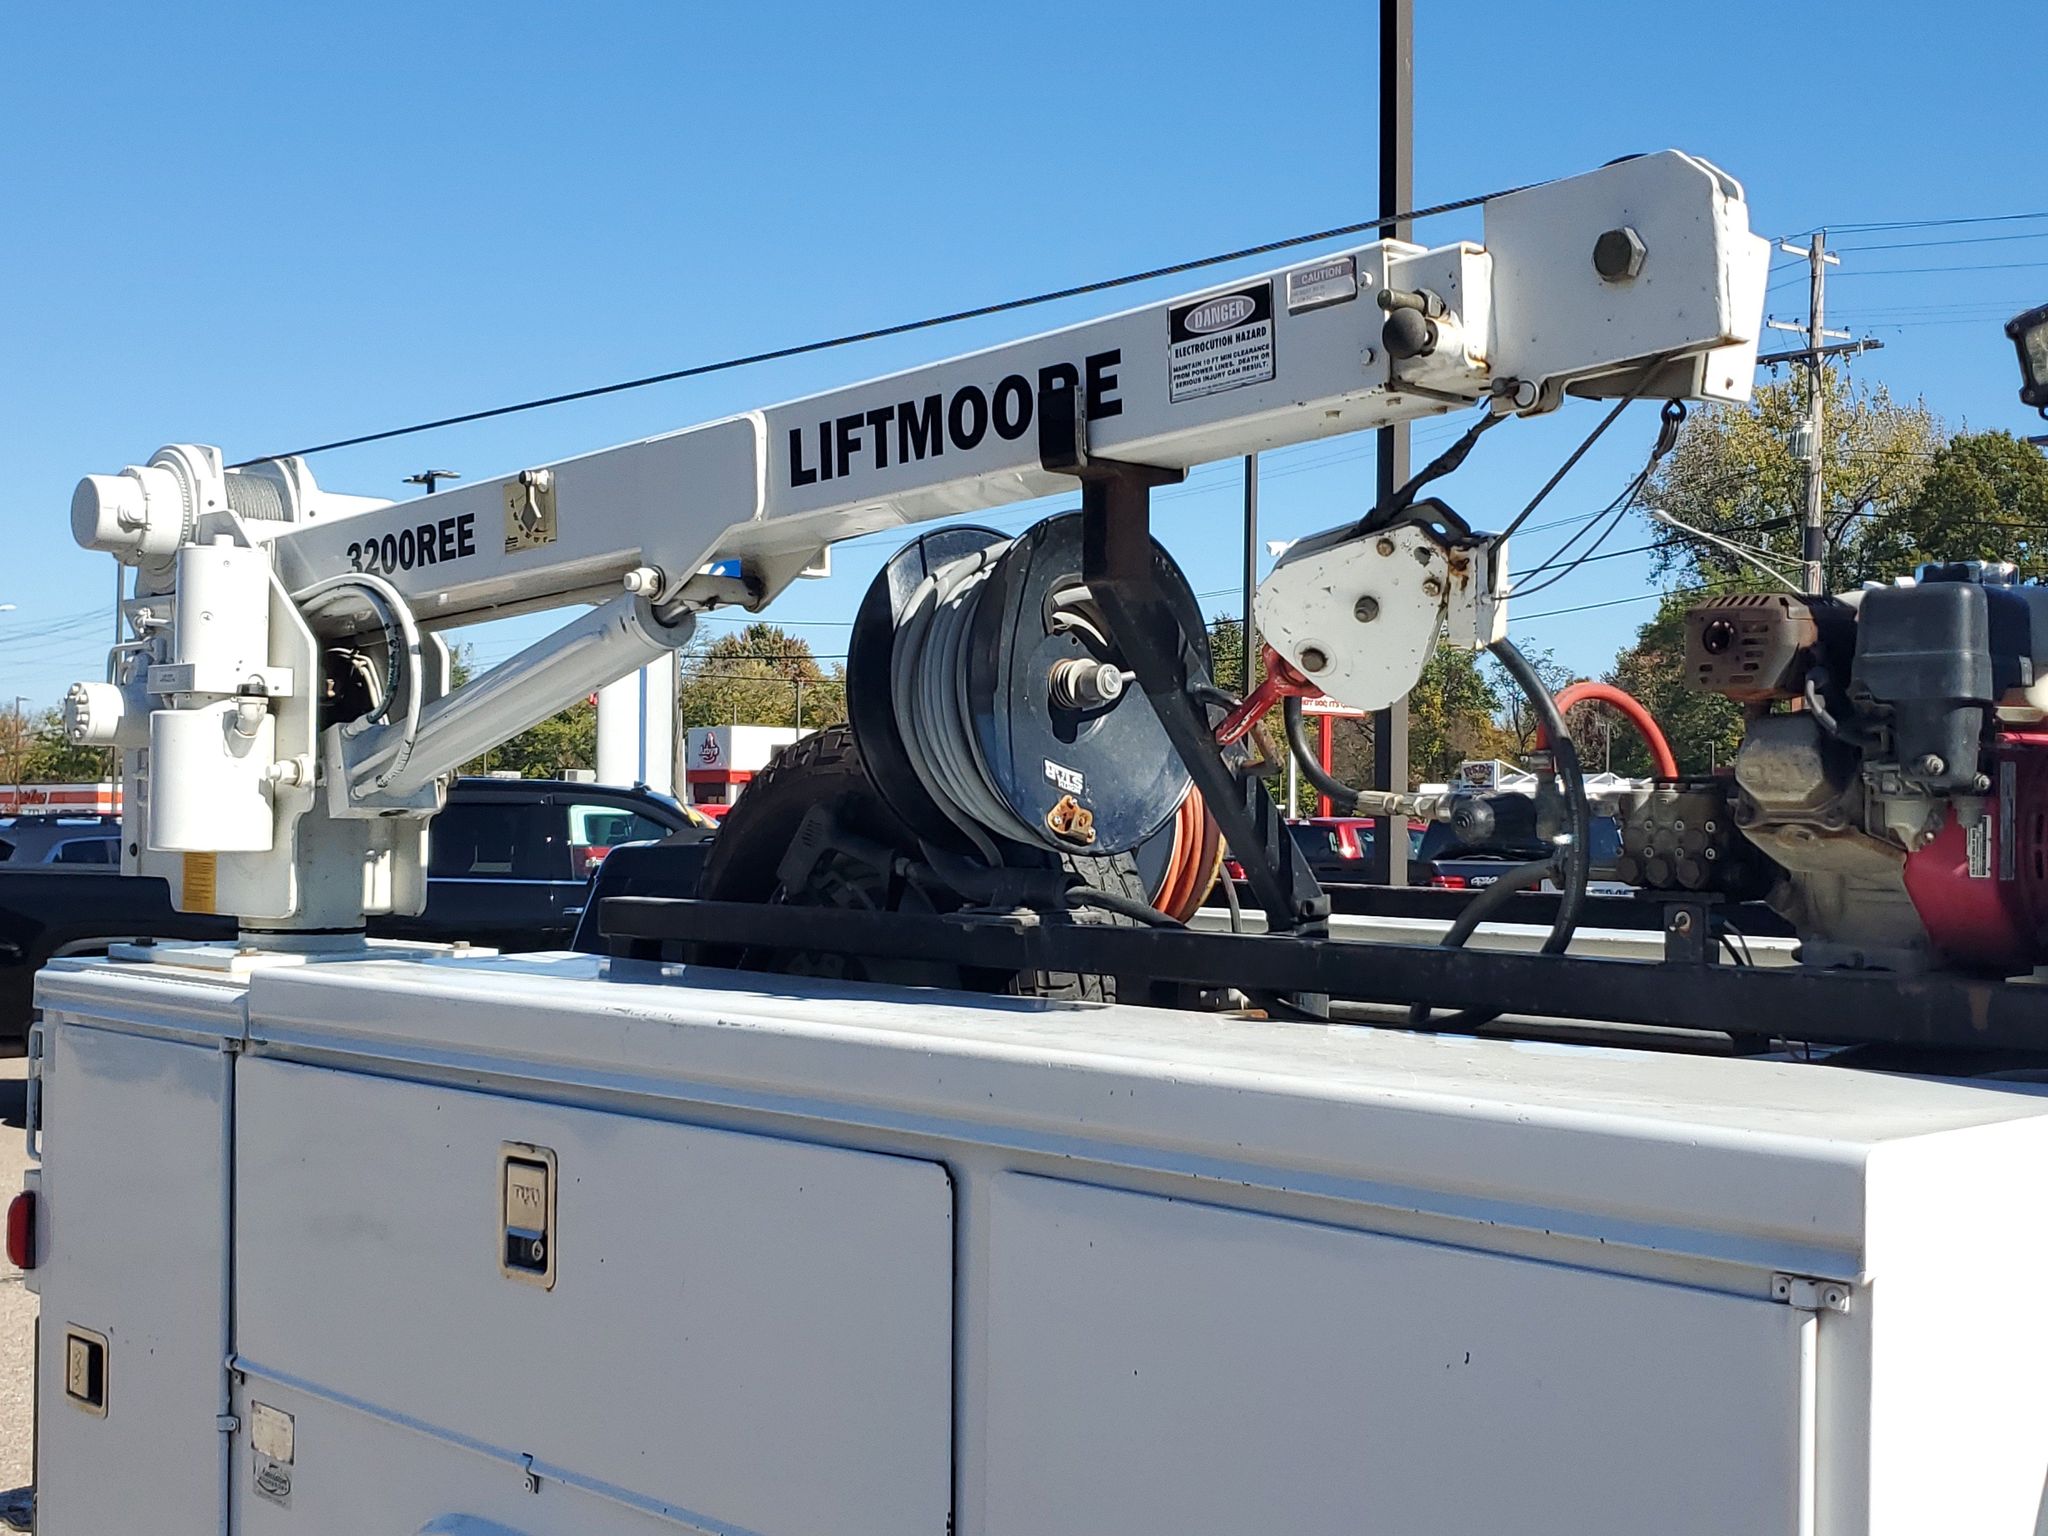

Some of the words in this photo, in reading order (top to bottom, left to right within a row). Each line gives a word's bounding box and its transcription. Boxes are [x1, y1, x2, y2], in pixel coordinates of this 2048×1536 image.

[1301, 265, 1342, 284] CAUTION
[1194, 300, 1245, 329] DANGER
[1175, 335, 1233, 359] ELECTROCUTION
[1235, 326, 1267, 343] HAZARD
[1173, 360, 1202, 373] MAINTAIN
[1203, 358, 1211, 366] 10
[1212, 356, 1219, 364] FT
[1220, 352, 1232, 362] MIN
[1233, 343, 1270, 359] CLEARANCE
[1173, 372, 1190, 381] FROM
[1191, 366, 1214, 377] POWER
[1238, 355, 1259, 366] DEATH
[1260, 351, 1270, 360] OR
[1175, 377, 1202, 389] SERIOUS
[1202, 370, 1226, 381] INJURY
[1227, 367, 1240, 376] CAN
[347, 512, 476, 576] 3200REE
